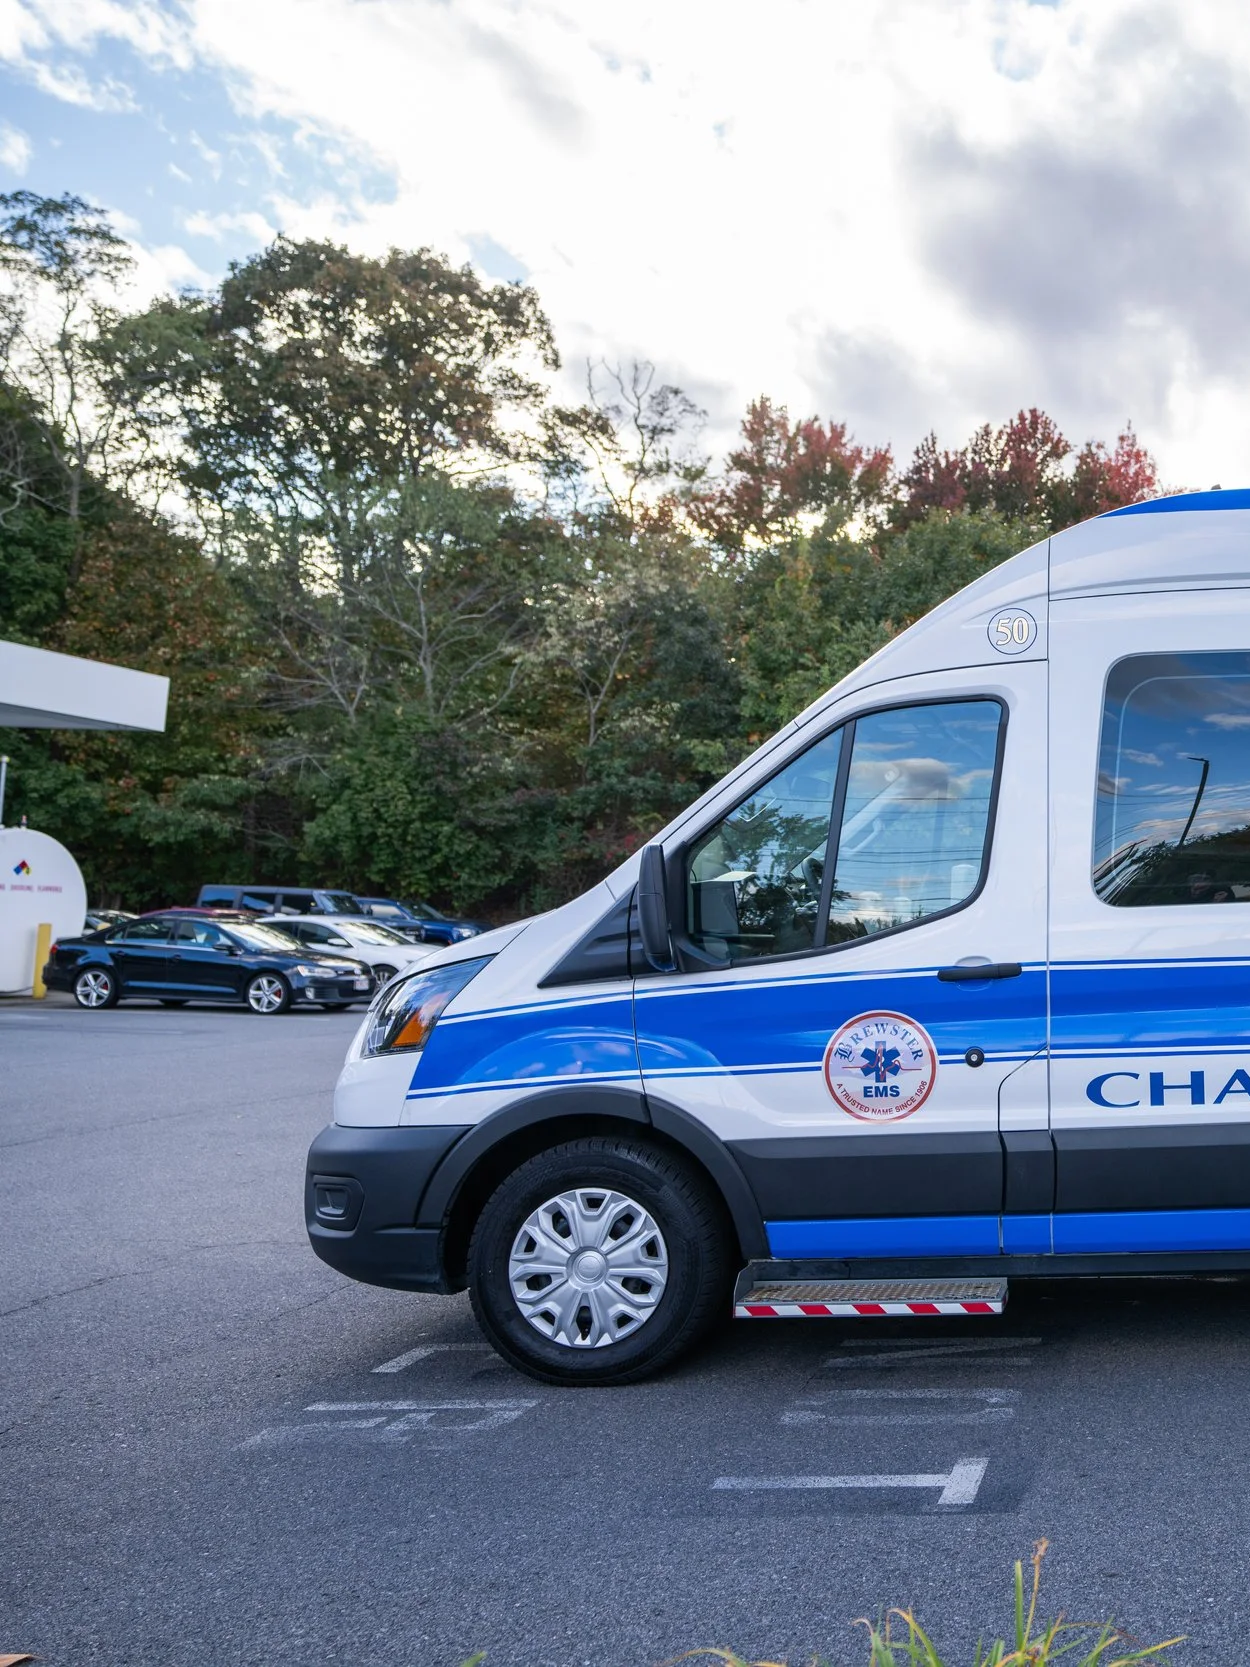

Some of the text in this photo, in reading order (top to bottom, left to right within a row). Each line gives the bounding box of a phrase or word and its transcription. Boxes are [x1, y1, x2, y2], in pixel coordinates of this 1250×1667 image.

[996, 616, 1029, 646] 50
[834, 1022, 924, 1062] BREWSTER
[840, 1088, 870, 1113] TRUSTED
[871, 1107, 893, 1115] NAME
[895, 1096, 917, 1112] SINCE
[863, 1085, 900, 1098] EMS
